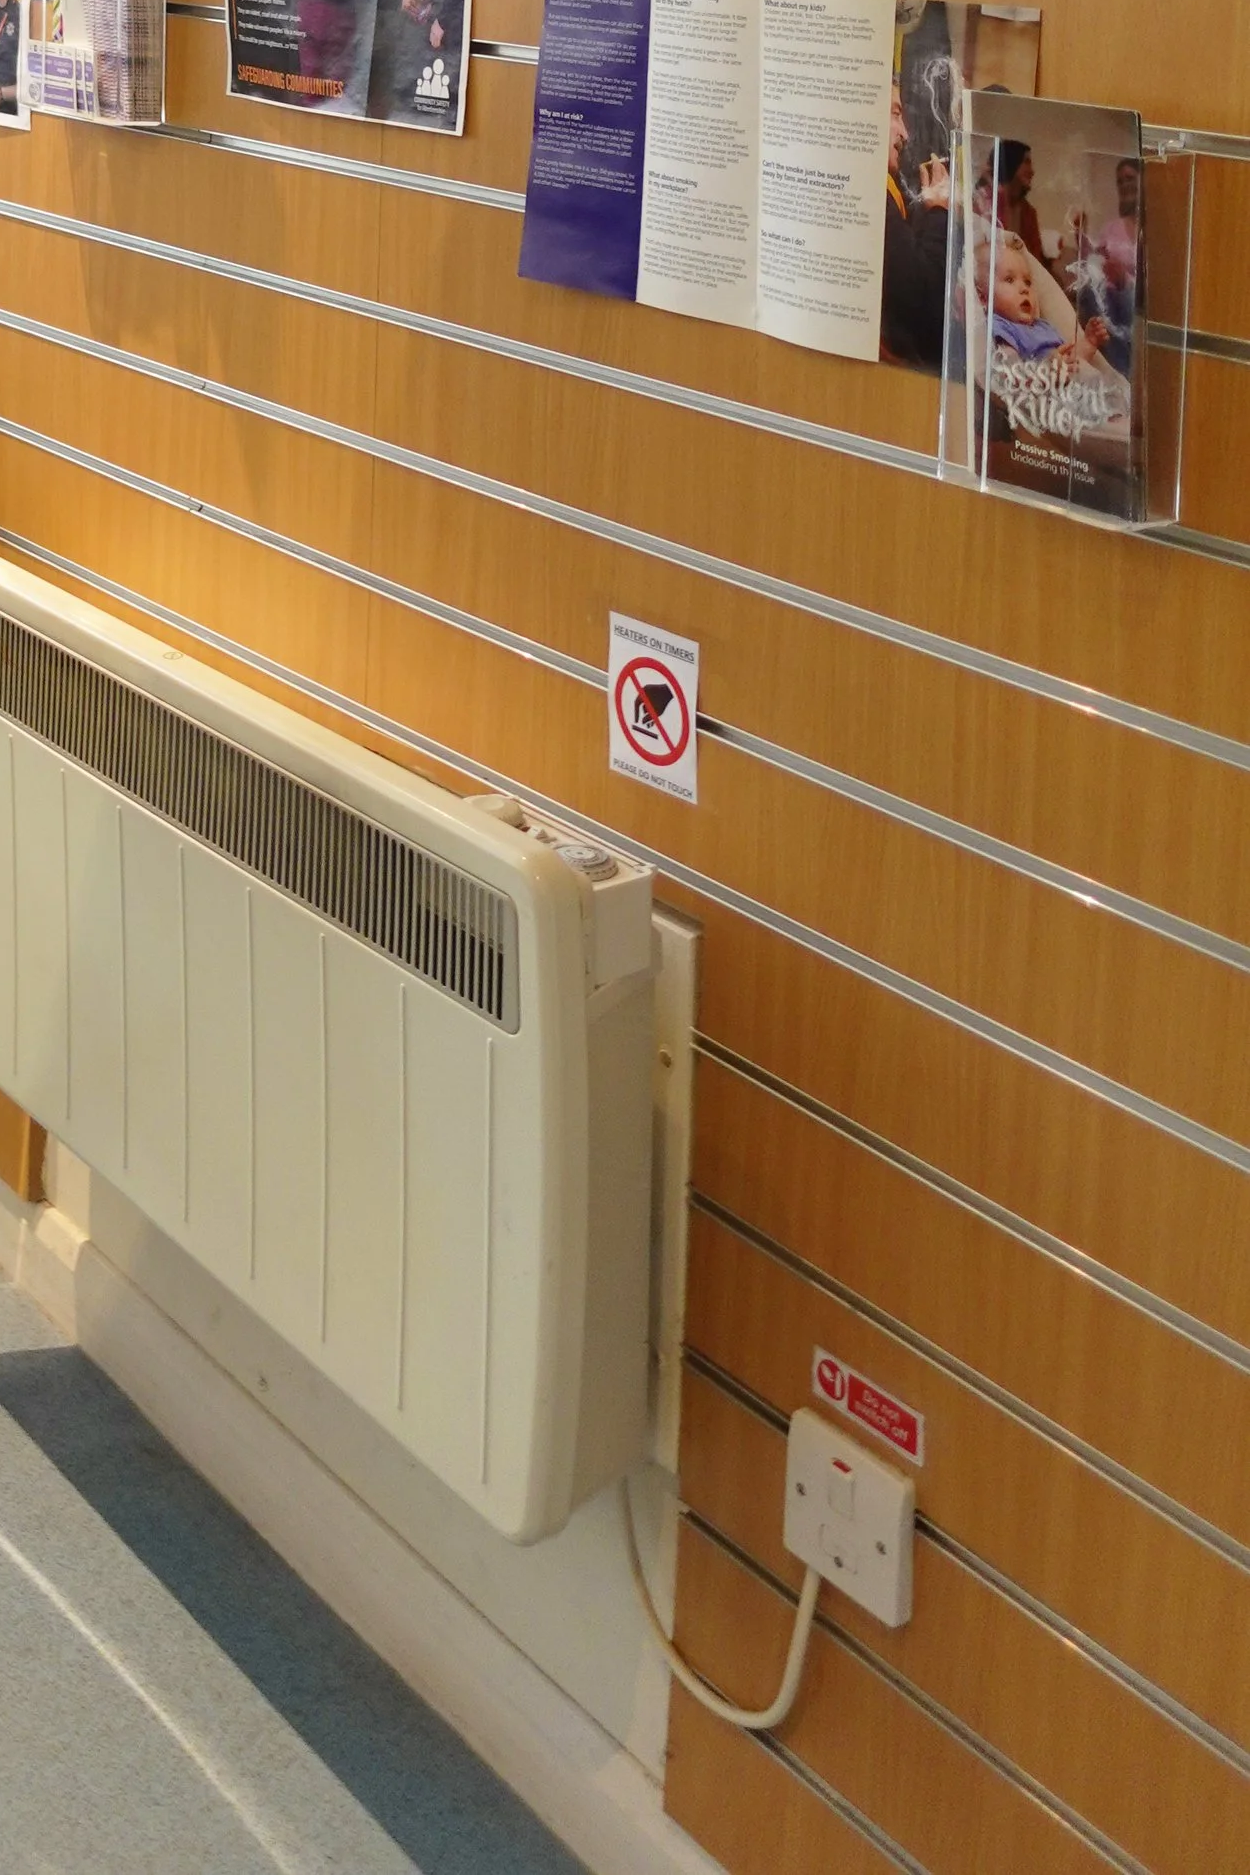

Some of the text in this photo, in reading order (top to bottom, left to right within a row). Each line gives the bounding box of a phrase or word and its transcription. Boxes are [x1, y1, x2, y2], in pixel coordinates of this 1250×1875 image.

[764, 0, 779, 7] What
[780, 1, 798, 9] about
[798, 4, 808, 12] my
[286, 74, 344, 99] COMMUNITIES
[539, 108, 552, 117] Why
[570, 113, 584, 121] risk?
[676, 175, 698, 187] smoking
[762, 159, 850, 182] Can't the smoke just be sucked
[762, 171, 845, 190] away by fans and extractors?
[760, 229, 767, 237] So
[768, 231, 780, 239] what
[795, 238, 806, 246] do?
[1001, 392, 1084, 444] Killer
[1014, 439, 1048, 457] Passive
[1010, 451, 1096, 485] Unclouding th issue
[613, 624, 696, 663] HEATERS ON TIMERS
[612, 757, 694, 799] PLEASE DO NOT TOUCH
